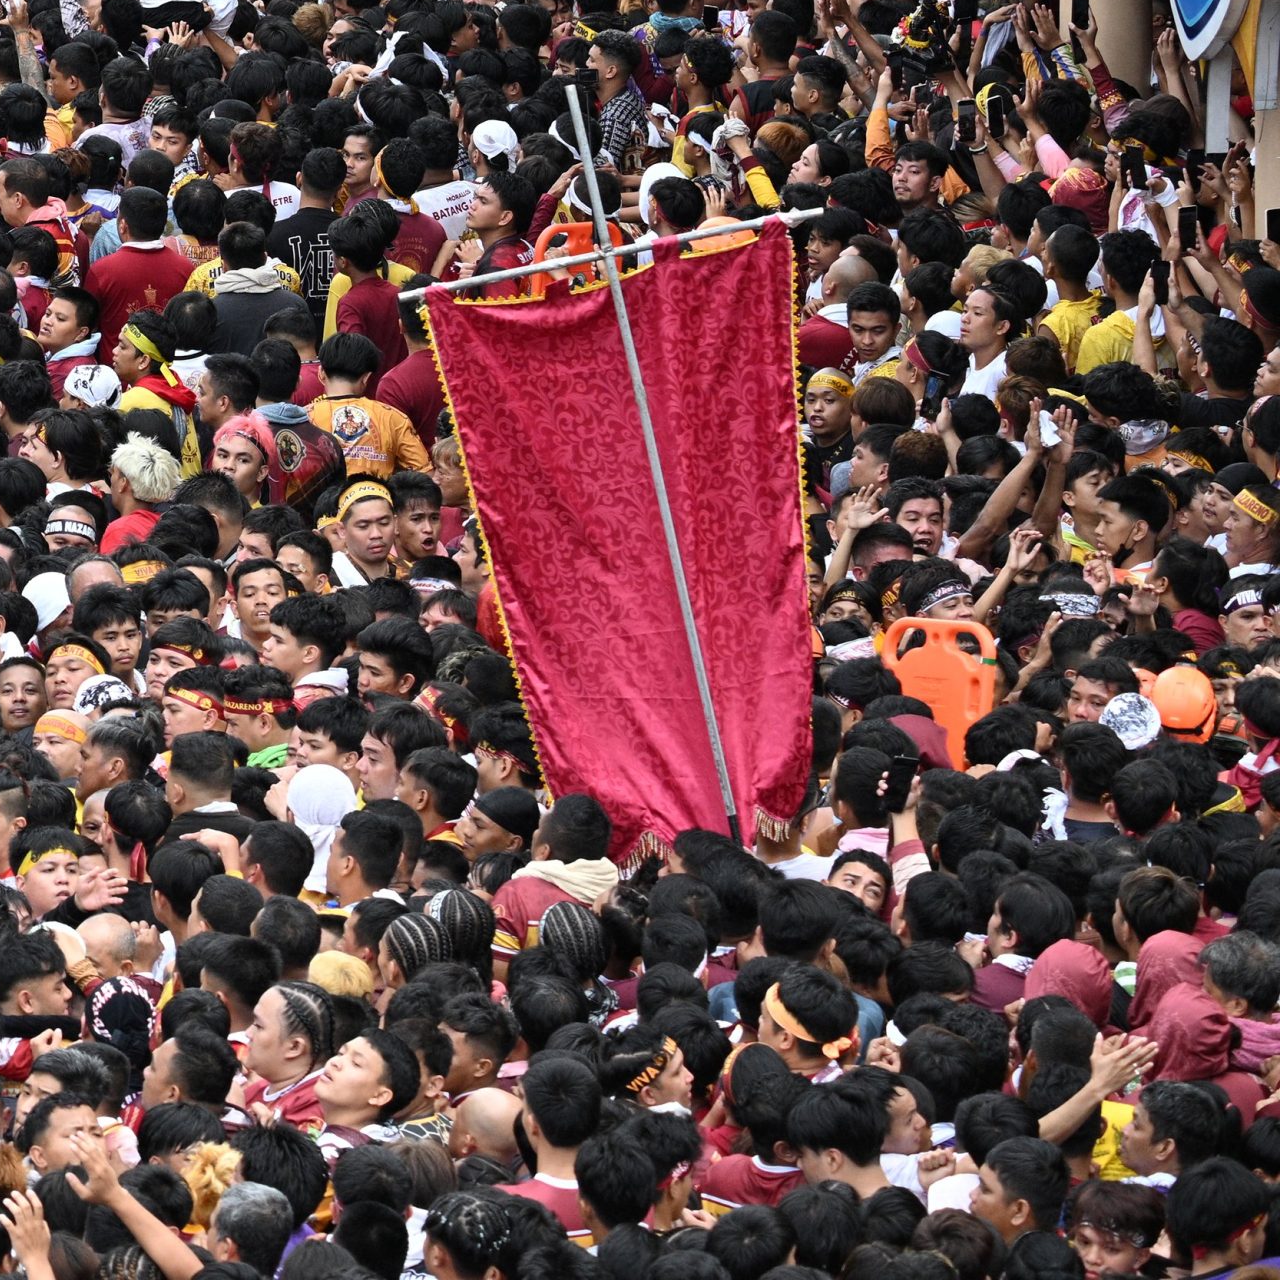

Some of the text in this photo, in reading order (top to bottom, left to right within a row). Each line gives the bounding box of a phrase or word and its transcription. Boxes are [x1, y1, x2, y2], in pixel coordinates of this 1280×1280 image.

[432, 204, 468, 220] BATANG
[1236, 590, 1256, 605] VIVA
[224, 699, 262, 712] NAZARENO
[626, 1067, 659, 1094] VIVA
